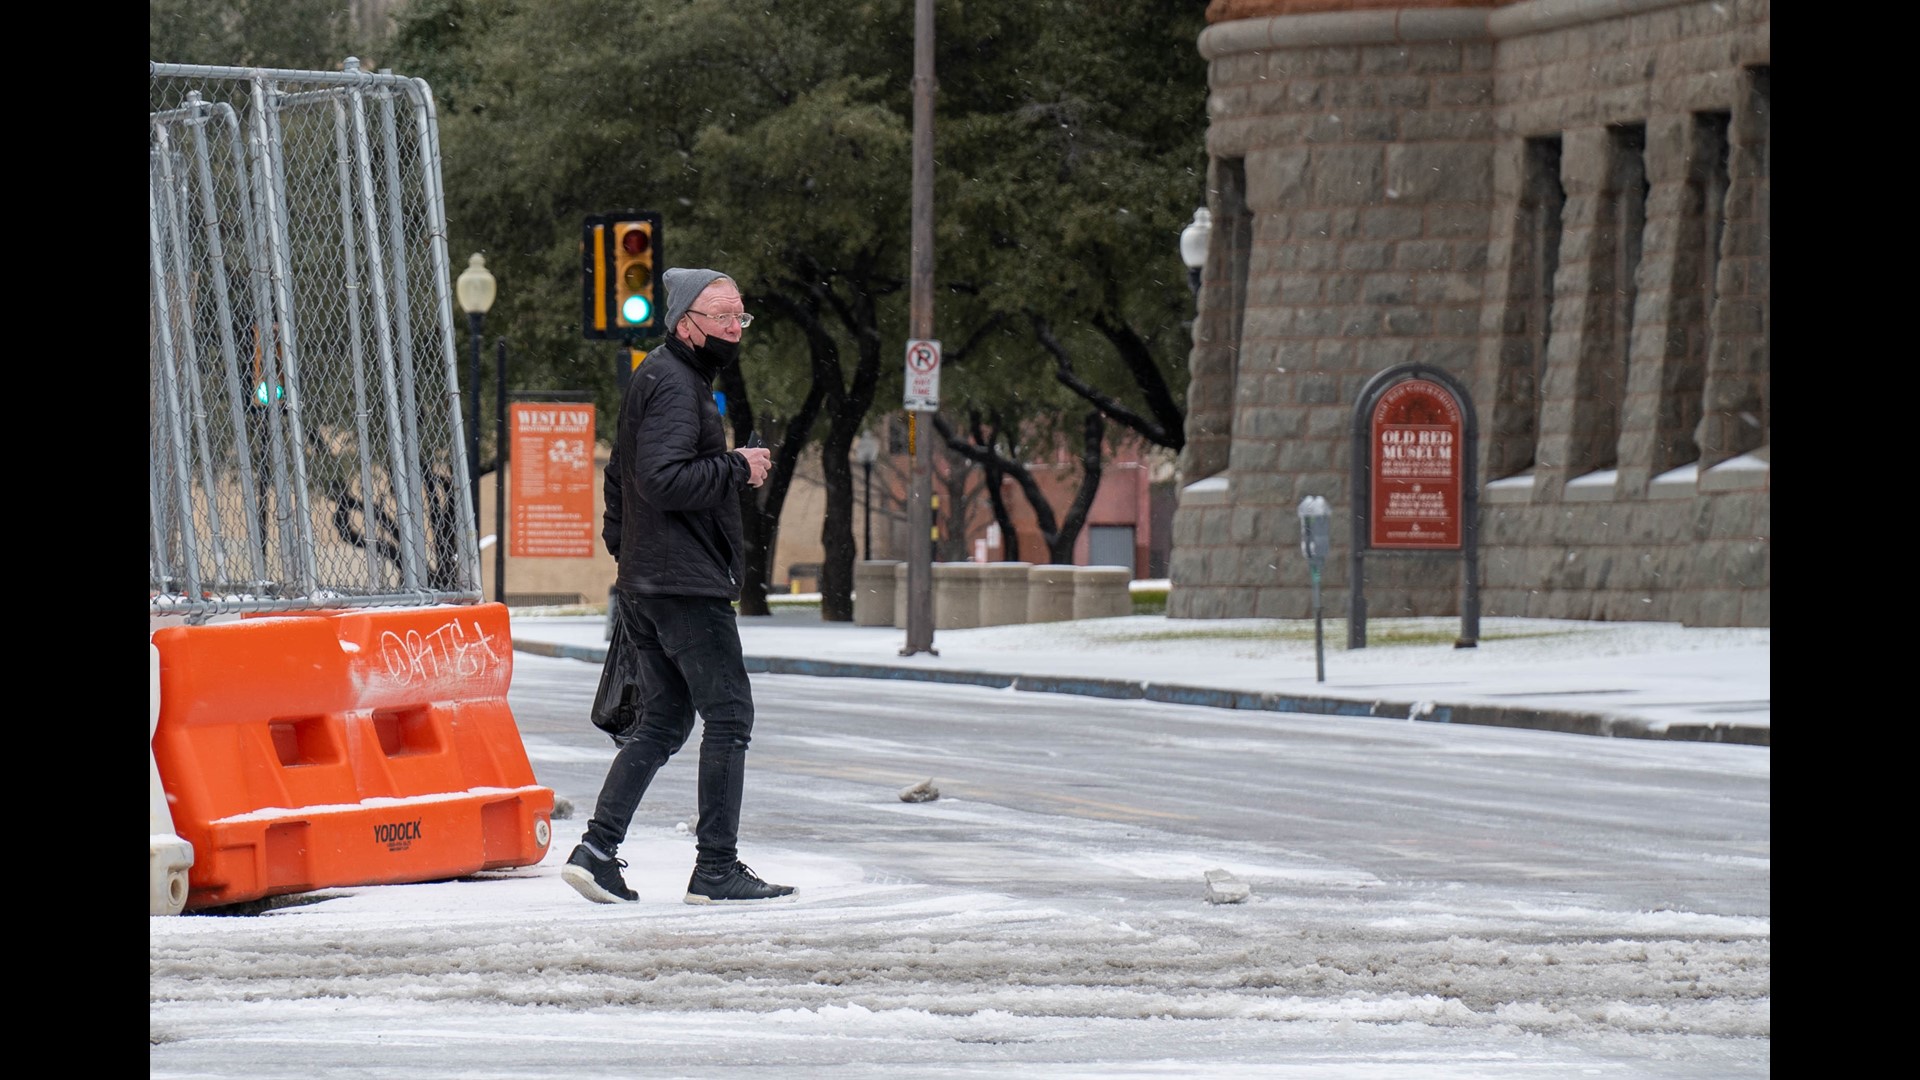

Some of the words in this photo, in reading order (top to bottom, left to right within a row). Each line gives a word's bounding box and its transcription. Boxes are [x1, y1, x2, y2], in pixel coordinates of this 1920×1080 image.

[912, 388, 930, 396] TIME
[518, 410, 558, 425] WEST
[559, 410, 590, 425] END
[1382, 430, 1416, 446] OLD
[1418, 430, 1453, 446] RED
[1382, 444, 1452, 460] MUSEUM
[373, 820, 422, 843] YODOCK
